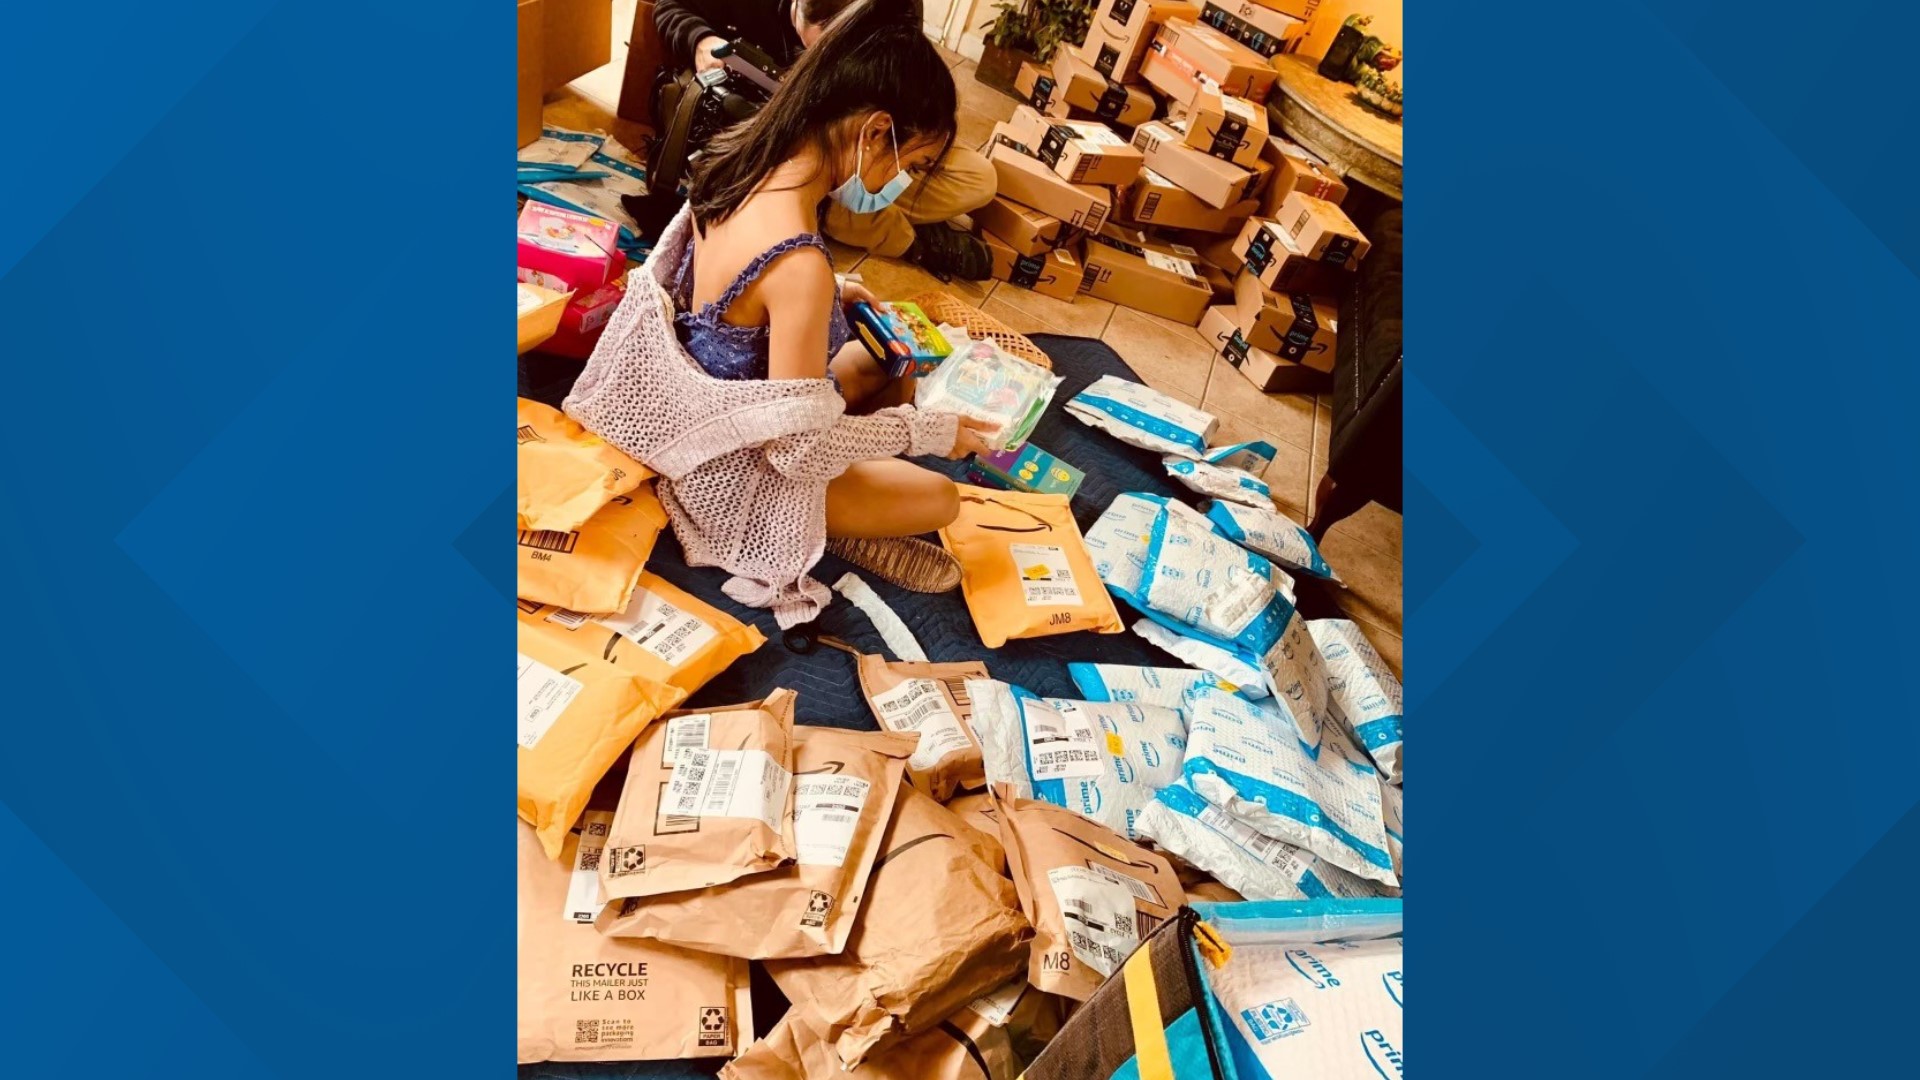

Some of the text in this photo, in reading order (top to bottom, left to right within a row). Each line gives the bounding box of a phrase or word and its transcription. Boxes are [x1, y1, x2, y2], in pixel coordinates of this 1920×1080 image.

[531, 551, 552, 561] BM4
[1049, 612, 1072, 626] JM8
[1362, 698, 1386, 711] prime
[1140, 740, 1155, 768] prime
[1113, 756, 1129, 784] prime
[1080, 781, 1094, 815] prime
[1125, 808, 1137, 839] rime
[572, 962, 648, 977] RECYCLE
[1043, 951, 1070, 971] M8
[1289, 949, 1341, 987] prime
[571, 978, 649, 987] THIS MAILER JUST
[571, 989, 645, 1001] LIKE A BOX
